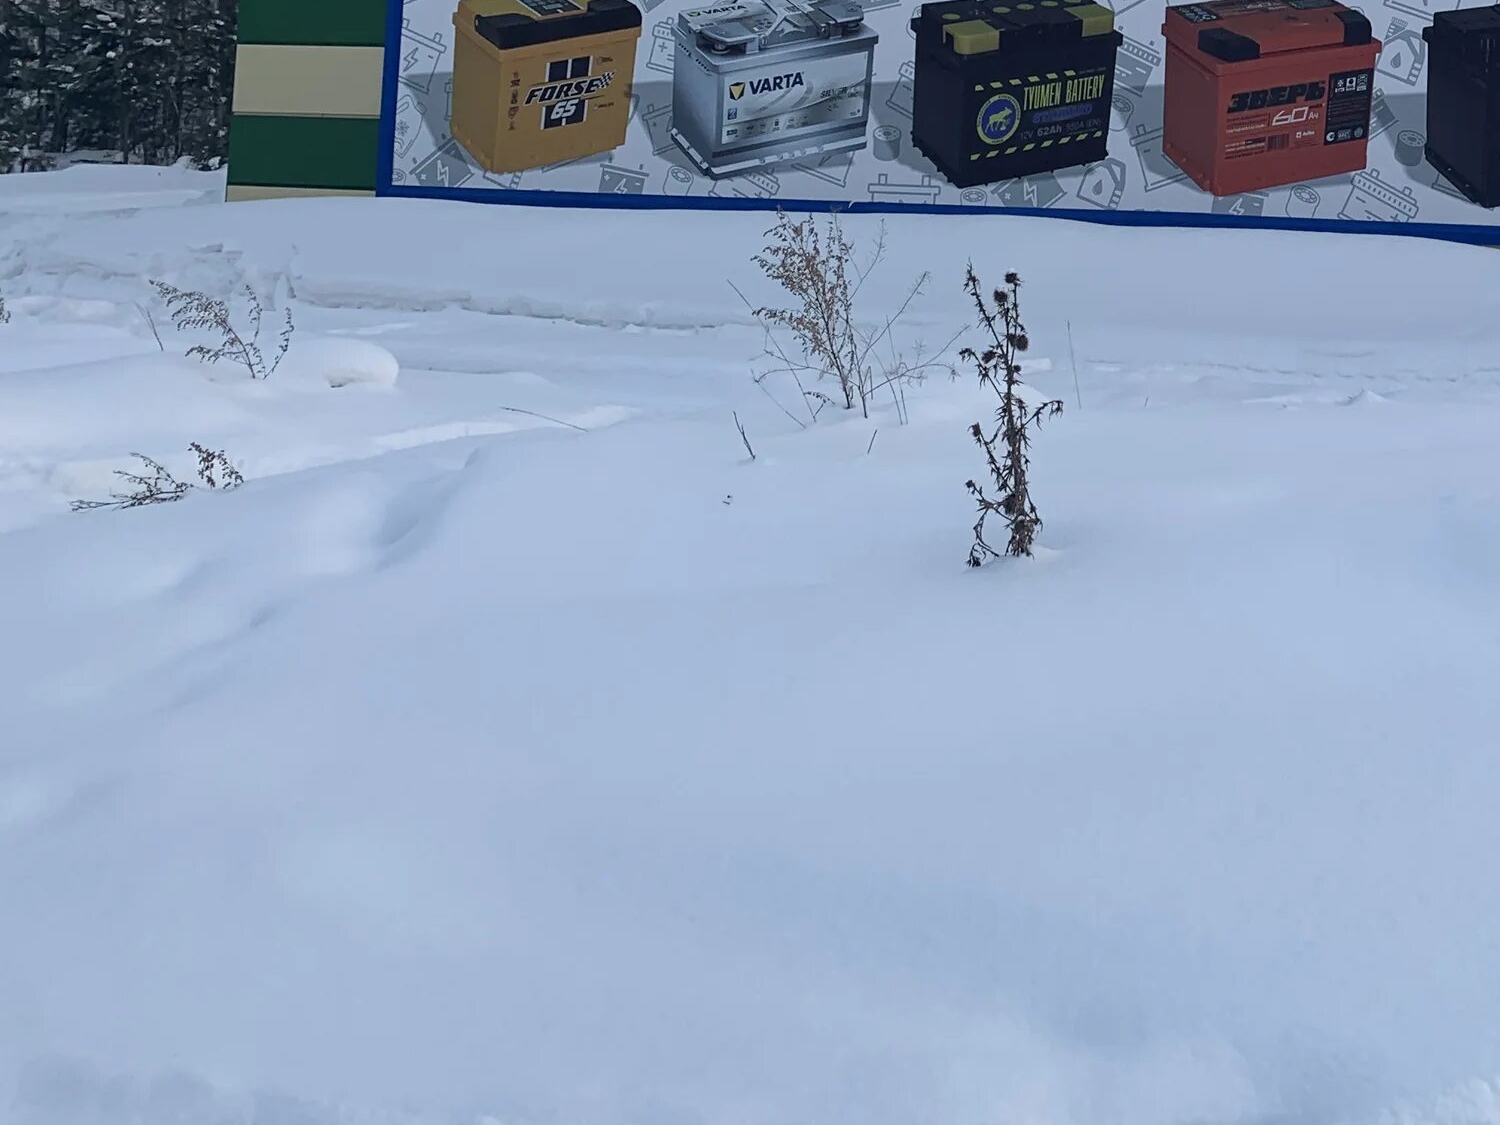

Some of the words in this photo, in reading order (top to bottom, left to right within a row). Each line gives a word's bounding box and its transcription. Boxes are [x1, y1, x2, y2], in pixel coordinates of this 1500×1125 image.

[524, 77, 602, 106] FORSE
[750, 72, 804, 95] VARTA
[1023, 82, 1062, 111] TYUMEN
[1065, 74, 1105, 104] BATTERY
[1227, 80, 1326, 114] ЗВЕРЬ
[551, 98, 579, 120] 65
[1272, 106, 1309, 126] 60
[1037, 125, 1062, 137] 62Ah
